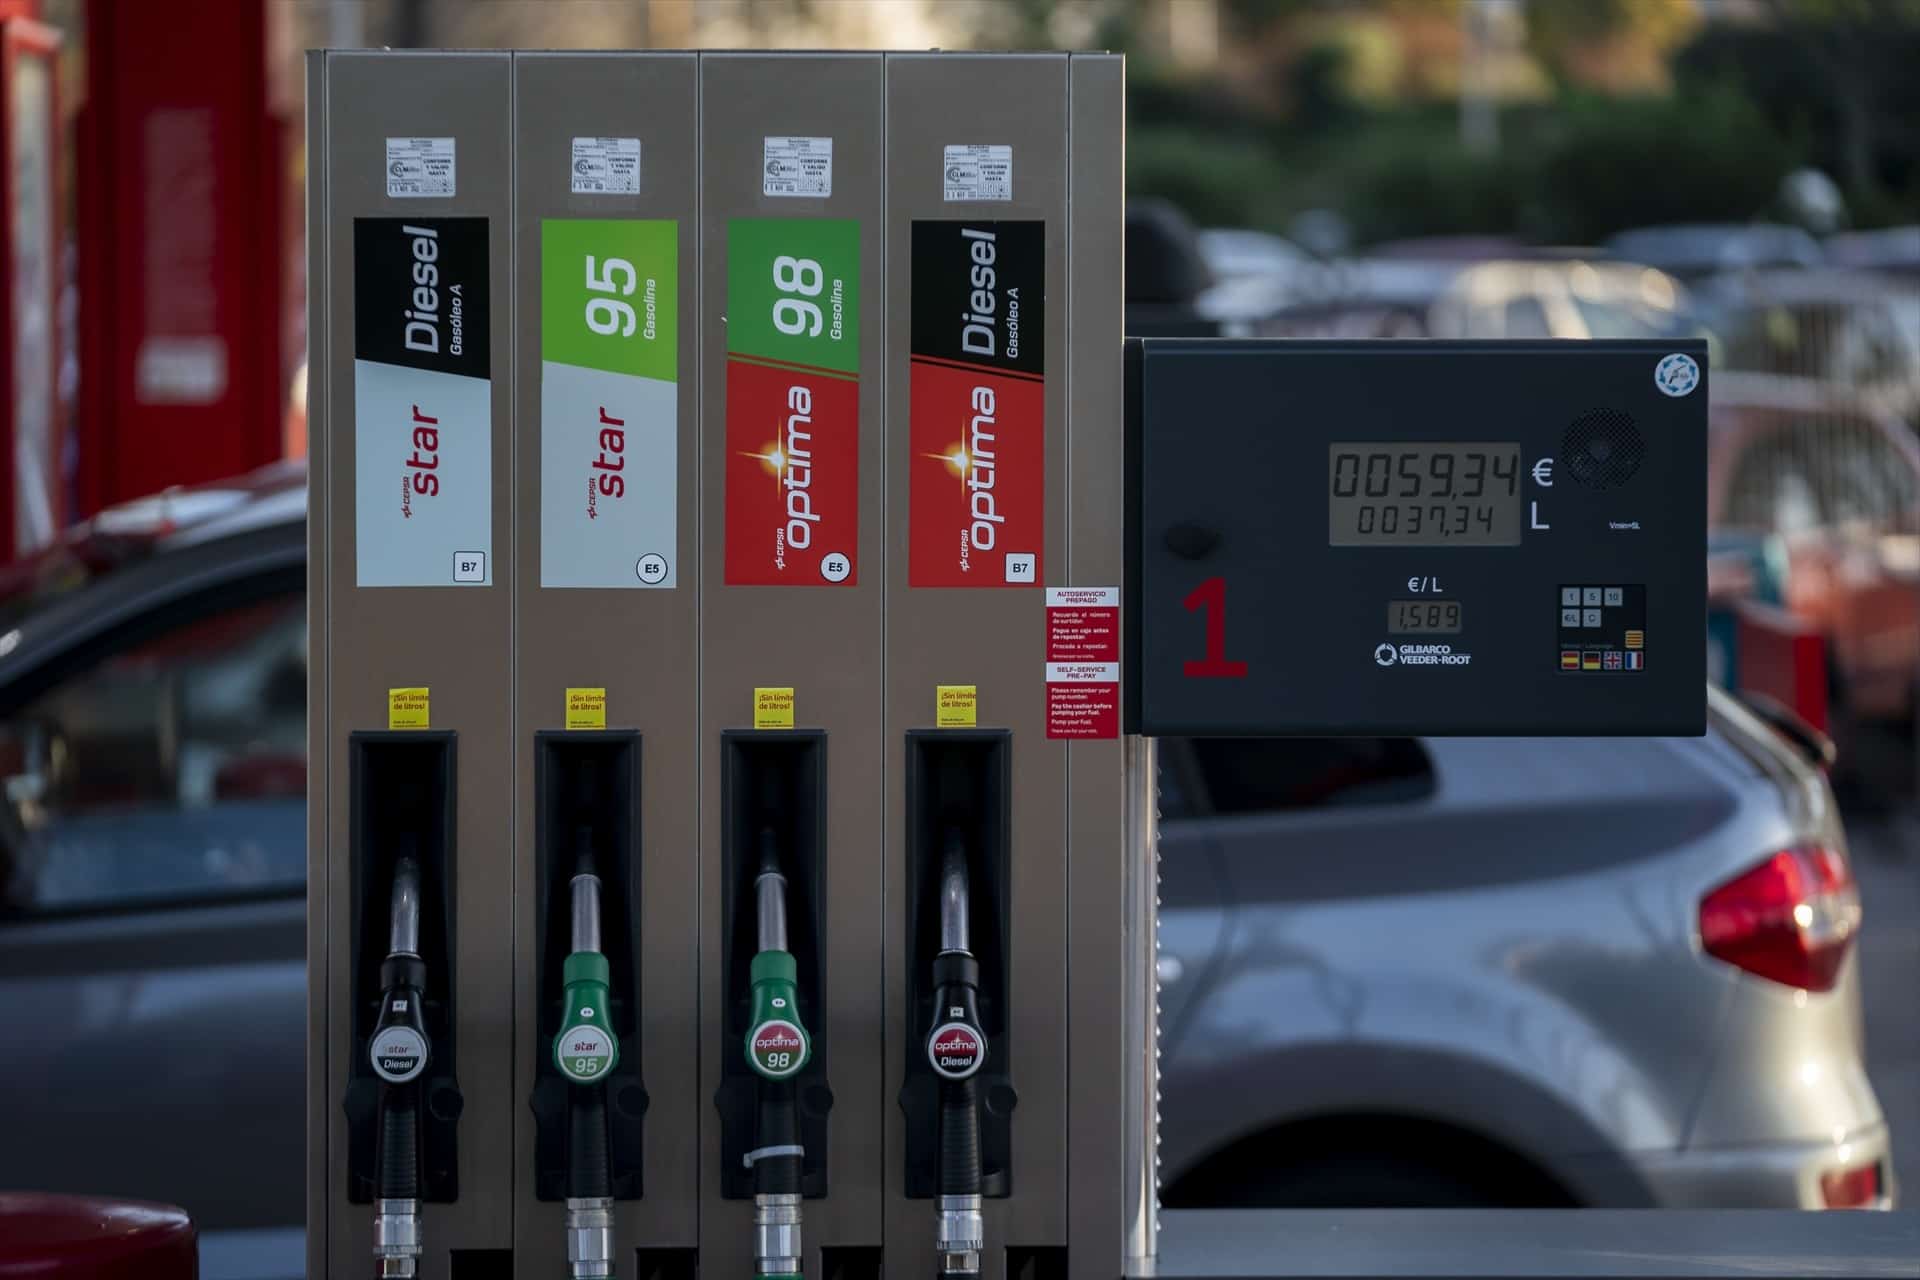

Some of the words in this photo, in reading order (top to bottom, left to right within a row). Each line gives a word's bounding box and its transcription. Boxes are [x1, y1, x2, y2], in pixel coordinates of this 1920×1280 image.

[402, 225, 439, 353] Diesel
[450, 284, 462, 296] A
[584, 255, 637, 338] 95
[772, 255, 824, 338] 98
[961, 228, 996, 356] Diesel
[1007, 287, 1019, 299] A
[643, 278, 656, 340] Gasolina
[830, 278, 843, 340] Gasolina
[450, 296, 463, 355] Gasóleo
[1006, 299, 1019, 359] Gasóleo
[406, 404, 439, 496] star
[592, 406, 625, 498] star
[783, 385, 820, 550] optima
[967, 386, 1005, 551] optima
[1332, 453, 1518, 500] 0059,34
[1532, 458, 1554, 487] €
[1357, 505, 1494, 537] 0037,34
[1531, 501, 1549, 529] L
[461, 561, 477, 572] B7
[644, 564, 659, 574] E5
[828, 562, 843, 573] E5
[1013, 563, 1027, 573] B7
[1183, 577, 1248, 678] 1
[1400, 605, 1459, 630] 1,589
[1400, 645, 1451, 654] GILBARCO
[1400, 655, 1472, 665] VEEDER-ROOT
[388, 1045, 408, 1054] star
[575, 1041, 597, 1051] star
[756, 1037, 799, 1049] optima
[935, 1041, 976, 1052] optima
[384, 1059, 413, 1069] Diesel
[575, 1058, 597, 1073] 95
[767, 1053, 789, 1068] 98
[941, 1056, 972, 1066] Diesel
